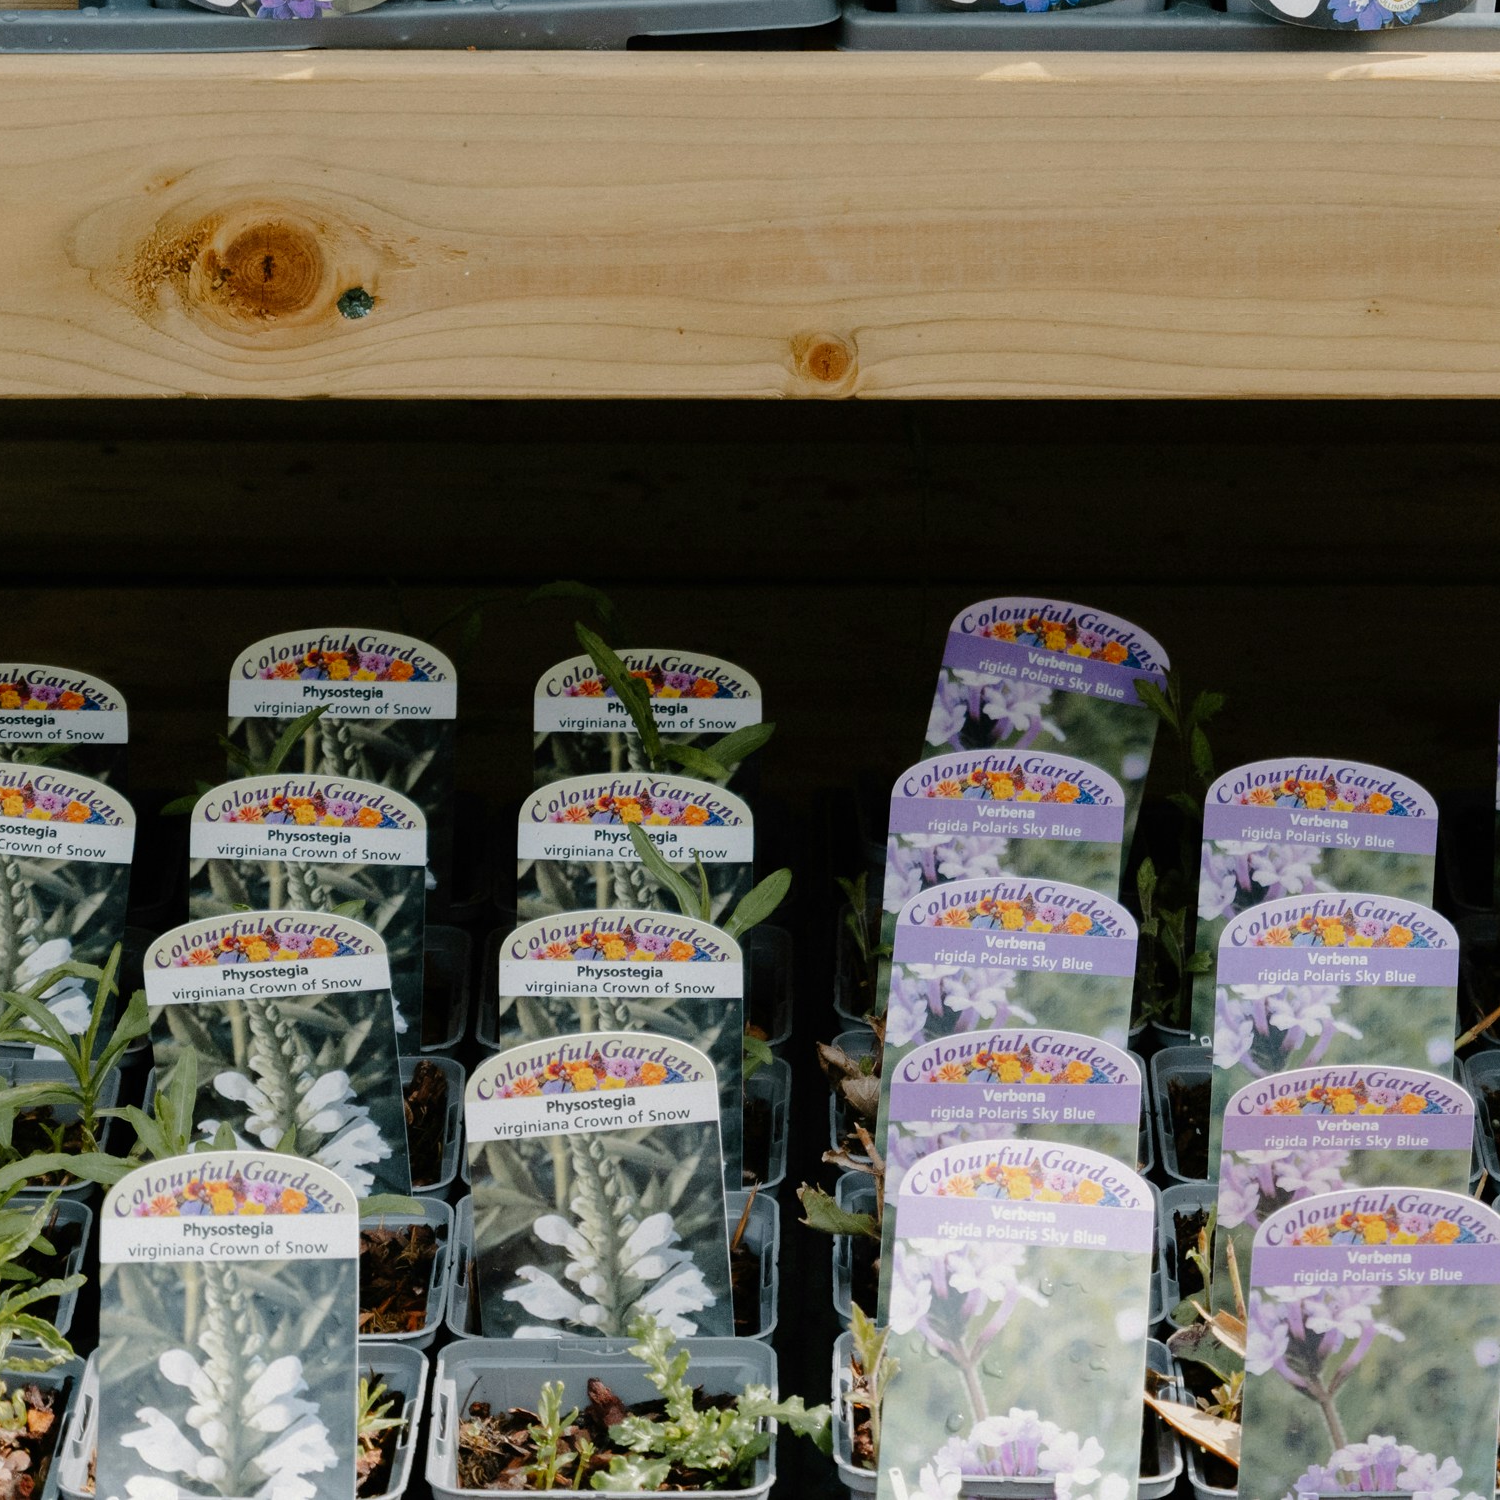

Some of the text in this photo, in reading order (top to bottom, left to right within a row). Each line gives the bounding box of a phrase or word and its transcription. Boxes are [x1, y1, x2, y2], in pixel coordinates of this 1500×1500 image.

[114, 1160, 345, 1218] Colourful Gardens
[1265, 1192, 1499, 1247] Colourful Gardens
[183, 1222, 274, 1239] Physostegia
[128, 1241, 329, 1260] virginiana Crown of Snow
[1347, 1250, 1412, 1265] Verbena
[1293, 1268, 1463, 1285] rigida Polaris Sky Blue
